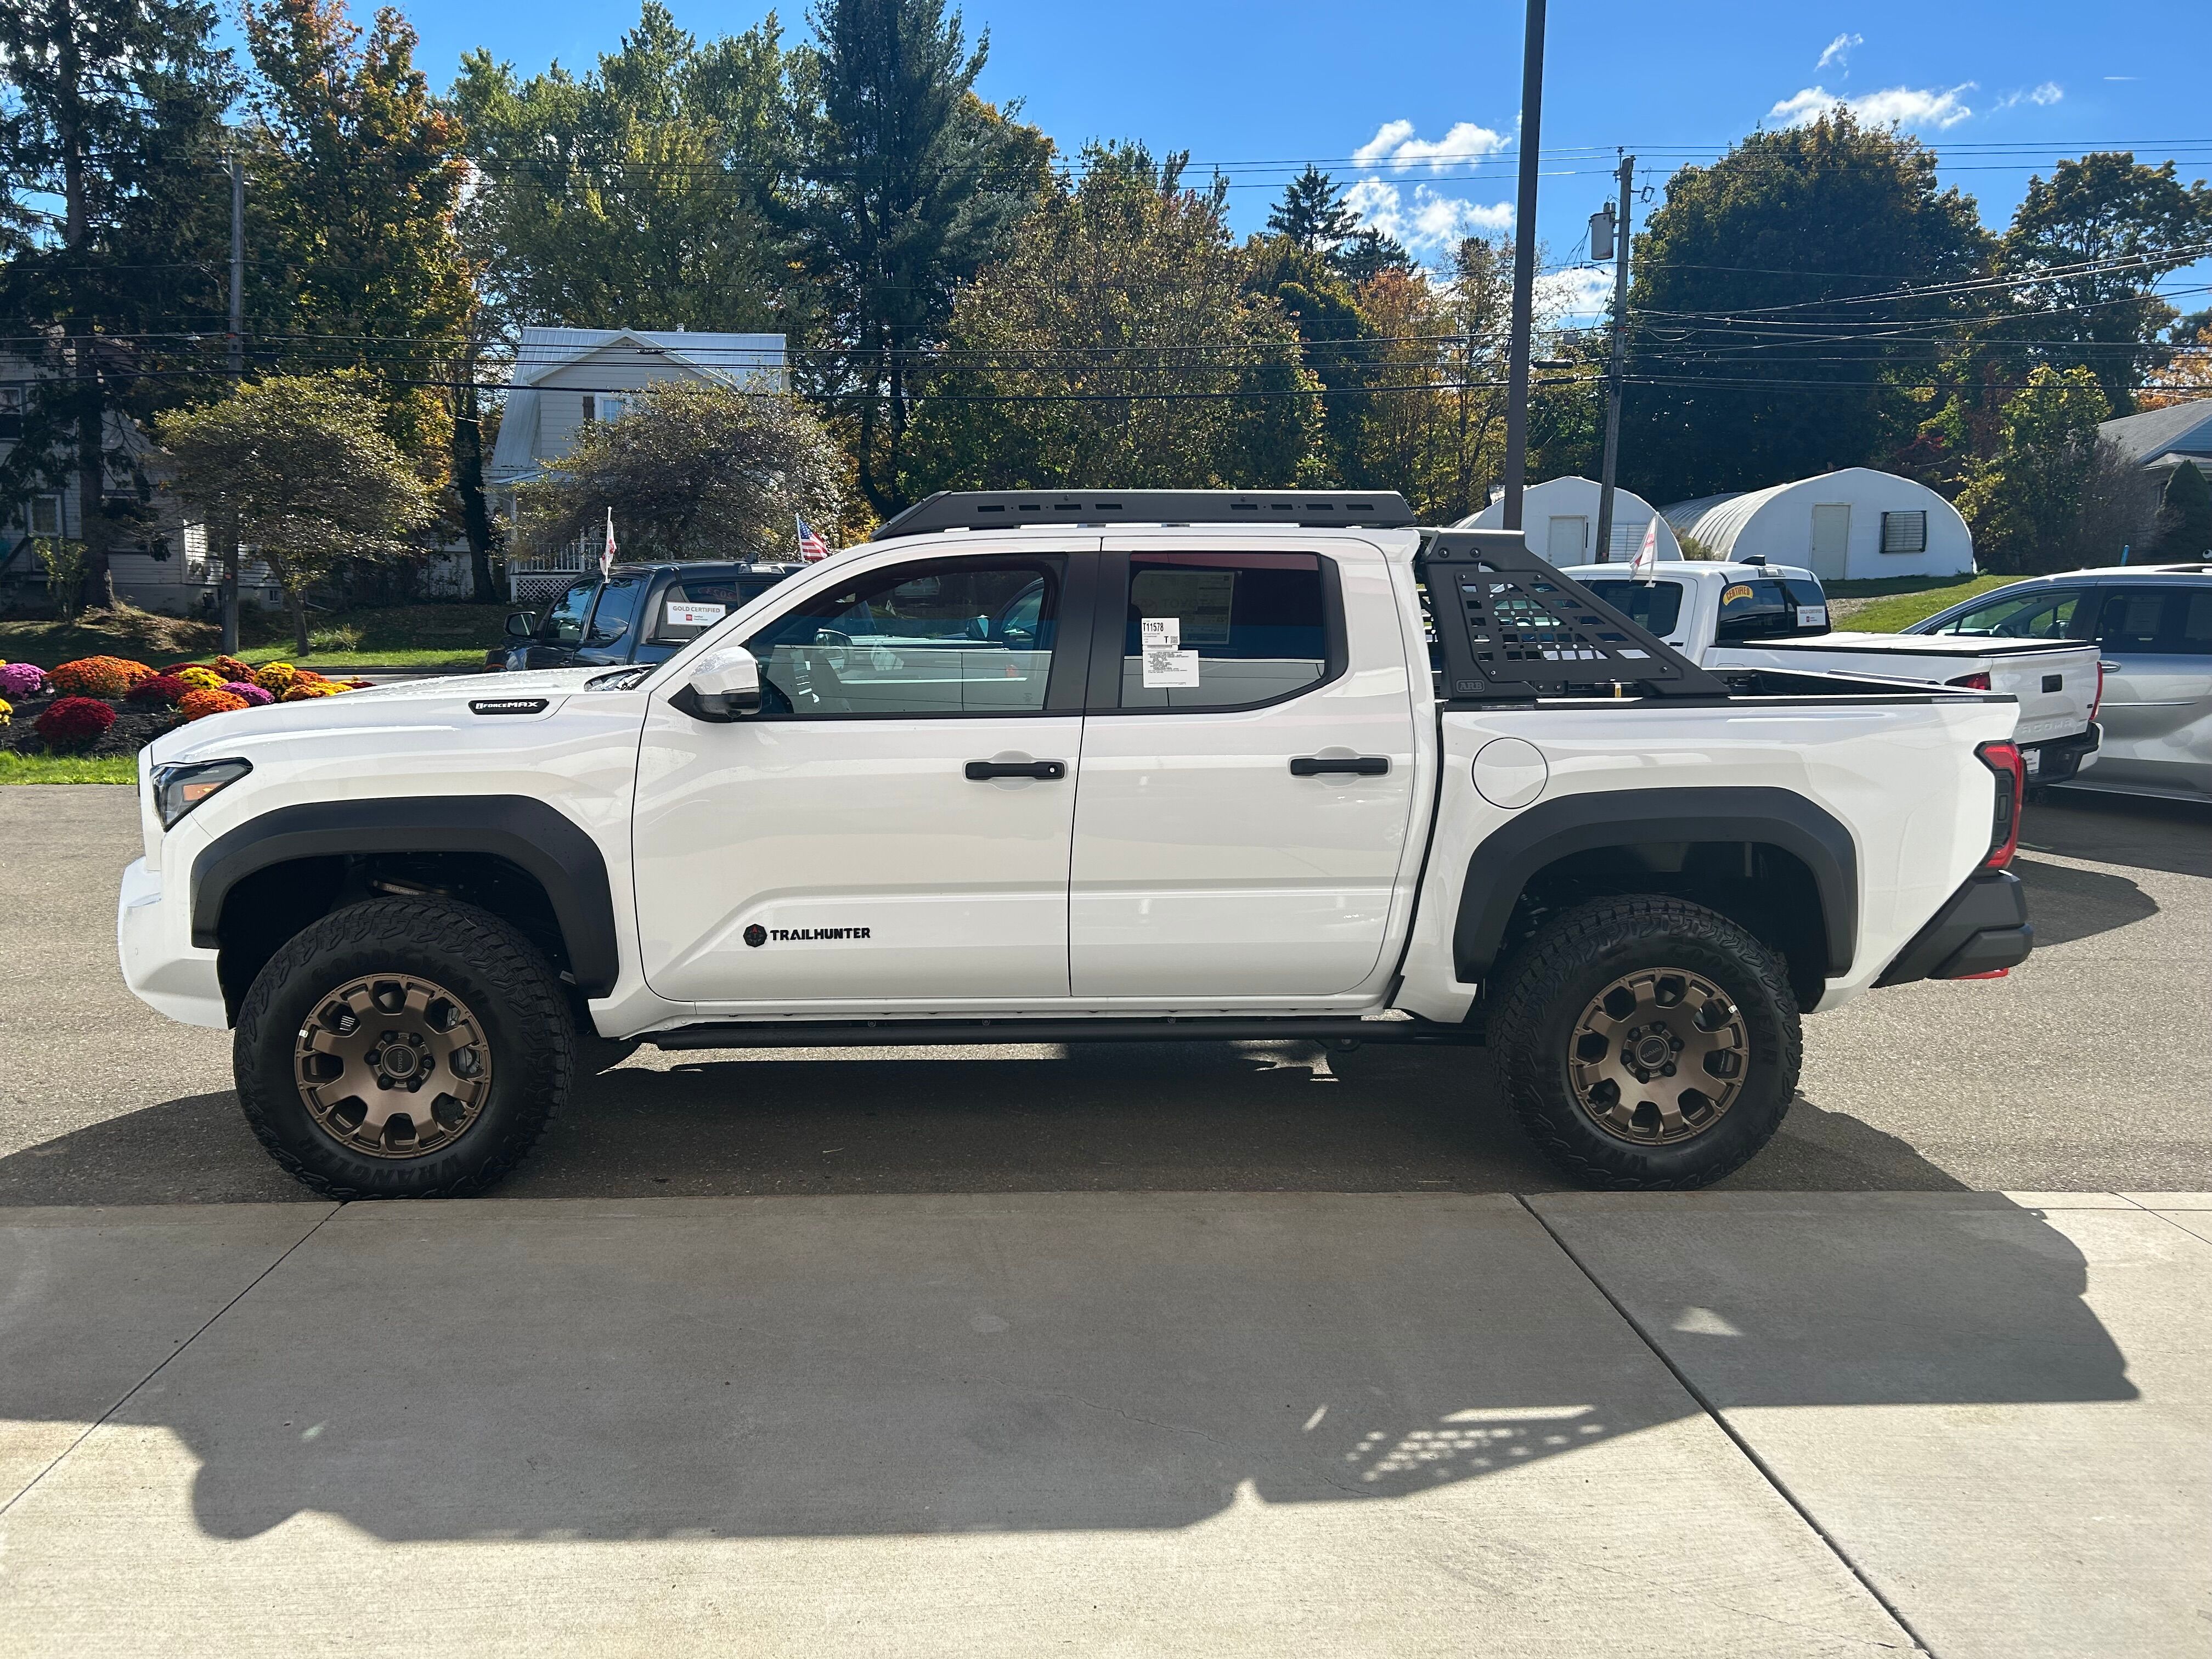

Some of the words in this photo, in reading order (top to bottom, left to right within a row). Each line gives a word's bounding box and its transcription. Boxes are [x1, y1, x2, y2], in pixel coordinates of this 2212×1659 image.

[1143, 622, 1164, 632] T11578
[1164, 636, 1169, 644] T
[1459, 682, 1482, 690] ARB
[770, 927, 871, 941] TRAILHUNTER
[1641, 1046, 1663, 1058] TOYOTA
